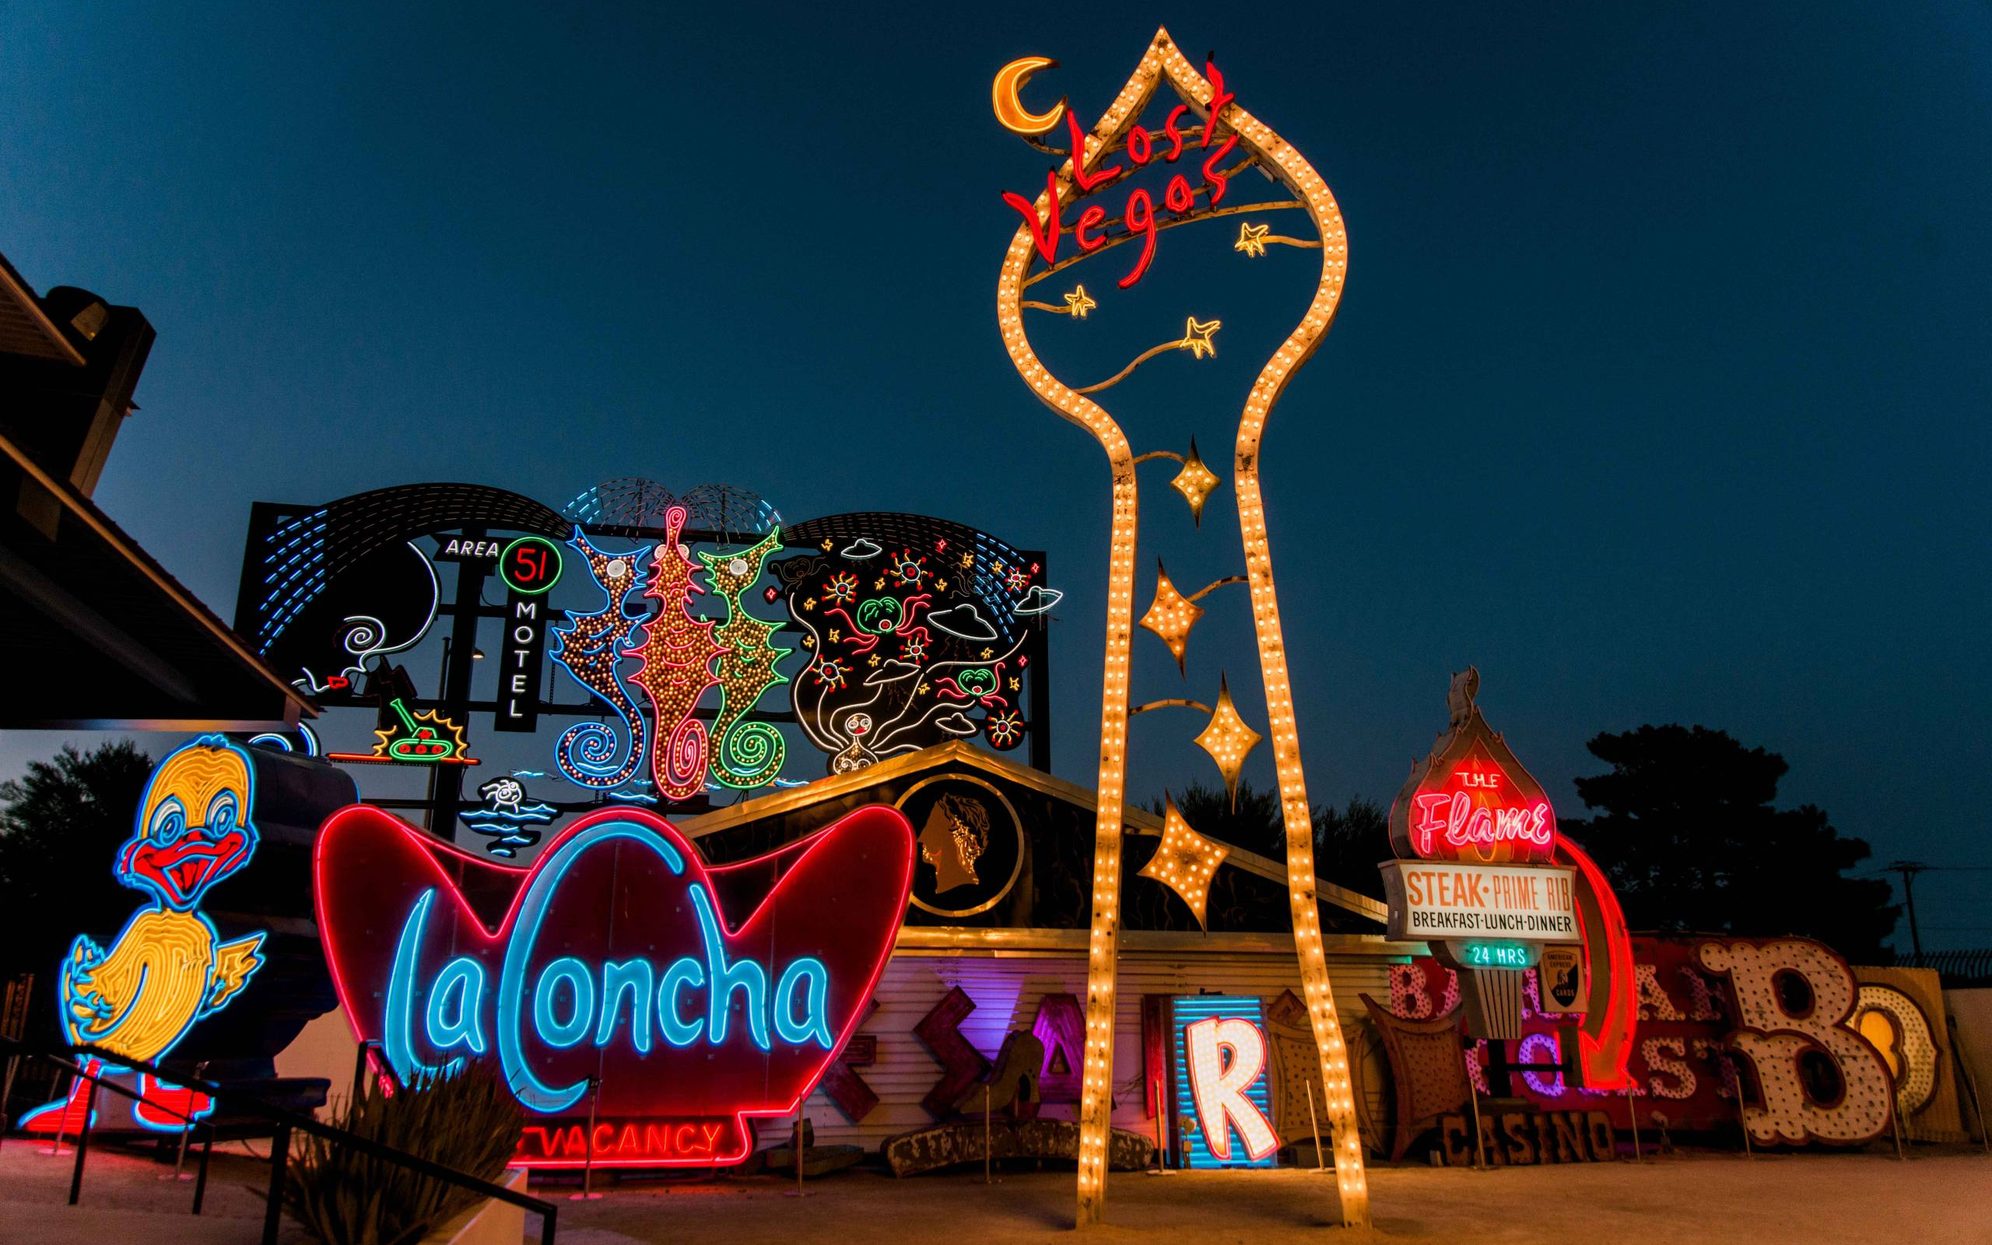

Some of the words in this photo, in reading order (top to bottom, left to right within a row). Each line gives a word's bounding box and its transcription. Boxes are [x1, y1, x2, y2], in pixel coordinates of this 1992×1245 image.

[1066, 55, 1235, 190] Lost
[1001, 132, 1238, 288] Vegas
[445, 539, 499, 558] AREA
[514, 547, 546, 582] 51
[510, 601, 536, 717] MOTEL
[1455, 772, 1501, 788] THE
[1415, 791, 1551, 854] Flame
[1546, 877, 1571, 912] RIB
[499, 820, 832, 1113] Concha
[1472, 946, 1489, 964] 24
[1499, 947, 1526, 965] HRS
[1185, 1016, 1281, 1162] R
[534, 1123, 722, 1156] VACANCY
[1440, 1109, 1617, 1166] CASINO
